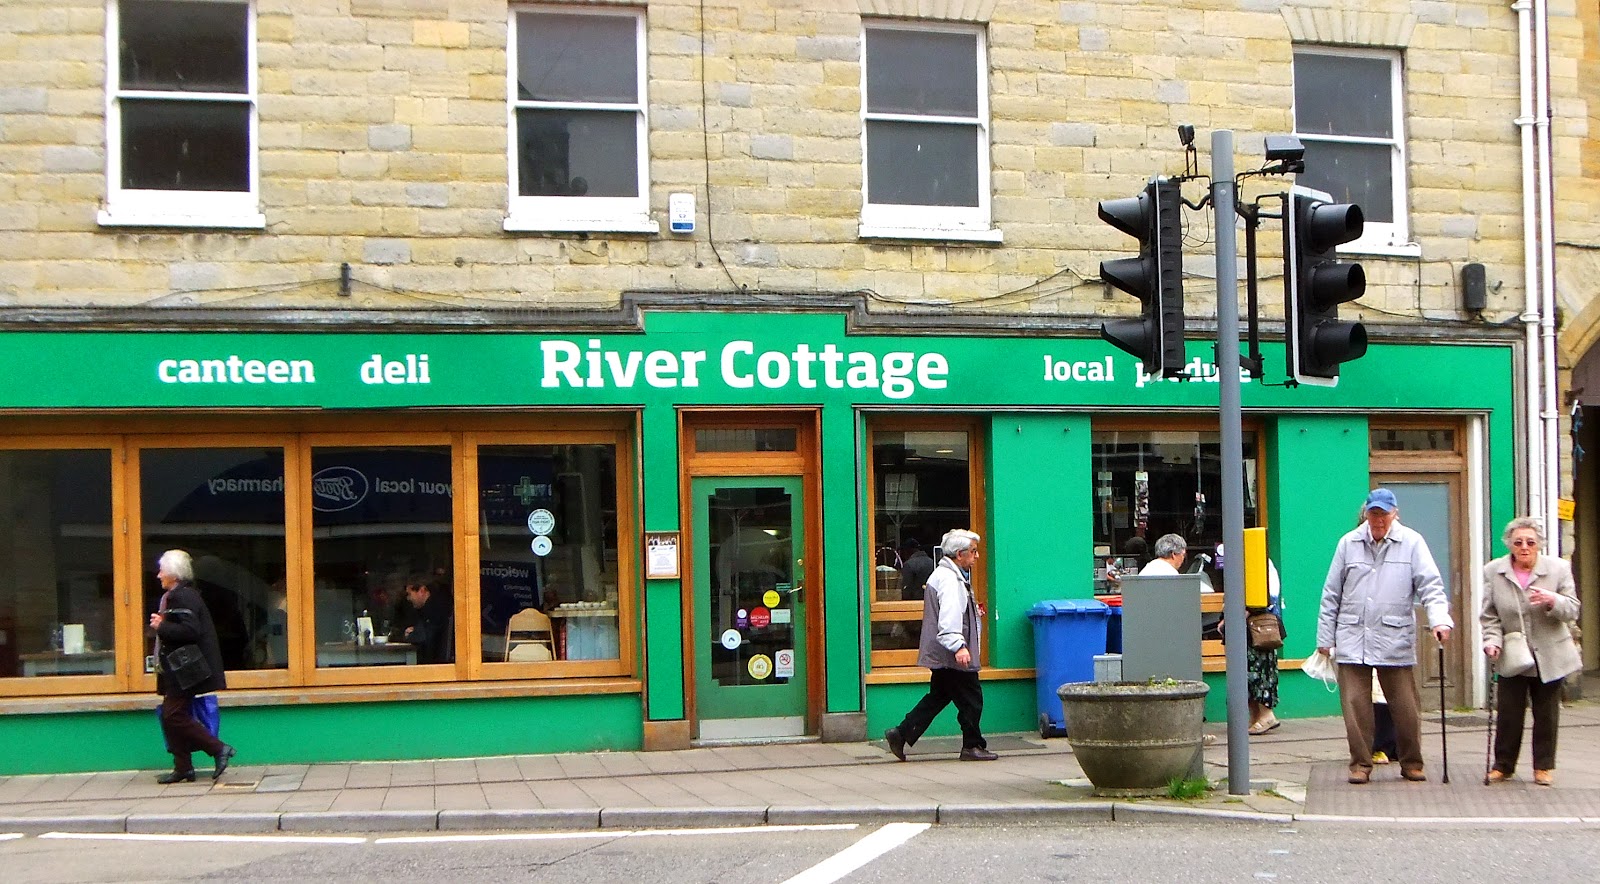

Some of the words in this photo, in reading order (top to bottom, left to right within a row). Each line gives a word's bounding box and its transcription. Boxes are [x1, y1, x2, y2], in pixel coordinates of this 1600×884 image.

[158, 355, 316, 384] canteen
[360, 354, 431, 385] deli
[540, 339, 707, 389] River
[720, 340, 949, 399] Cottage
[1043, 355, 1115, 382] local
[1135, 357, 1252, 388] pdue
